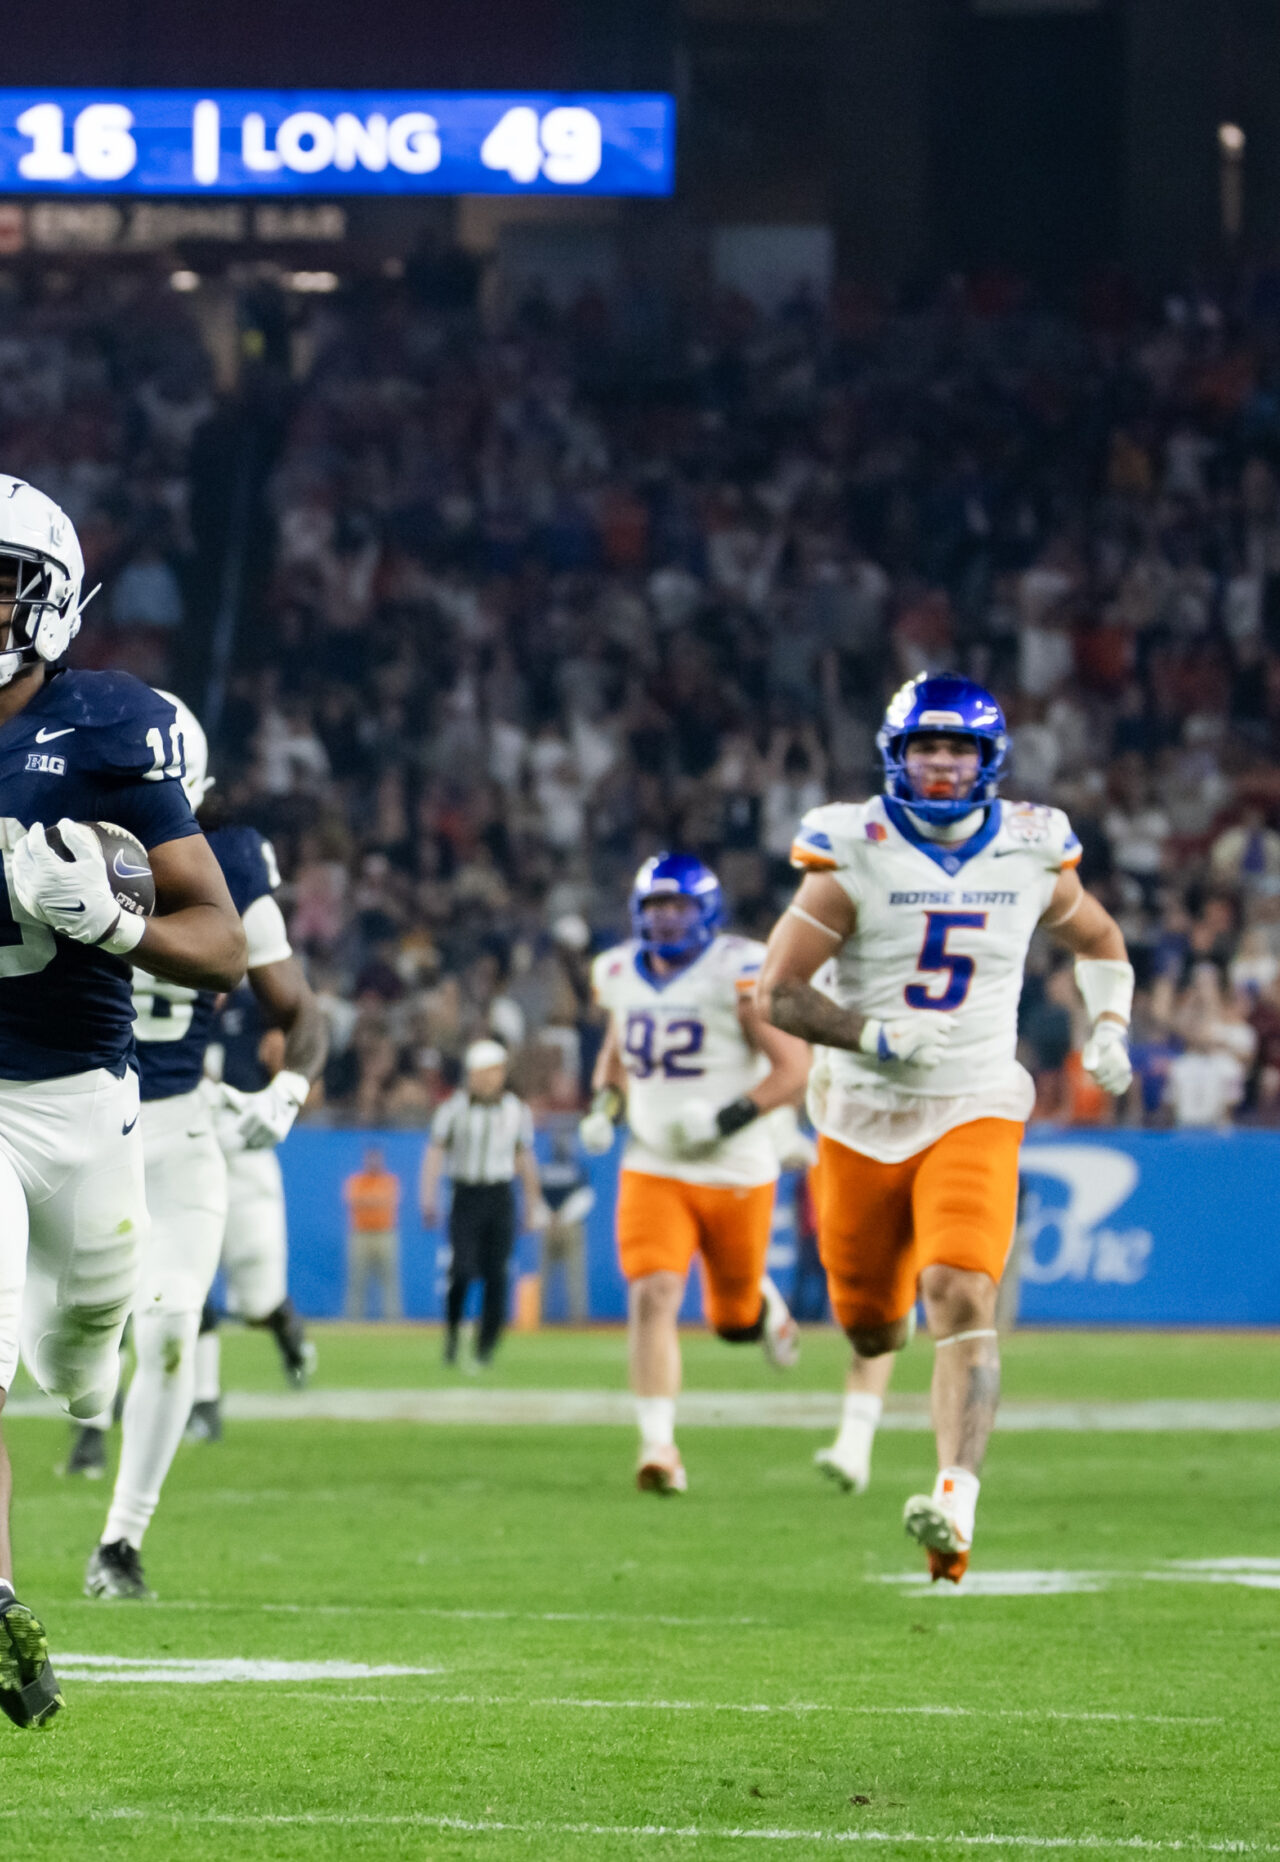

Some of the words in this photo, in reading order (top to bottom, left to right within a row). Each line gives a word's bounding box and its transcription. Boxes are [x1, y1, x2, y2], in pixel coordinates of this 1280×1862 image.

[17, 102, 136, 181] 16
[241, 112, 440, 175] LONG
[481, 106, 603, 185] 49
[888, 891, 954, 906] BOISE
[961, 890, 1019, 906] STATE
[904, 910, 989, 1012] 5
[625, 1013, 705, 1079] 92
